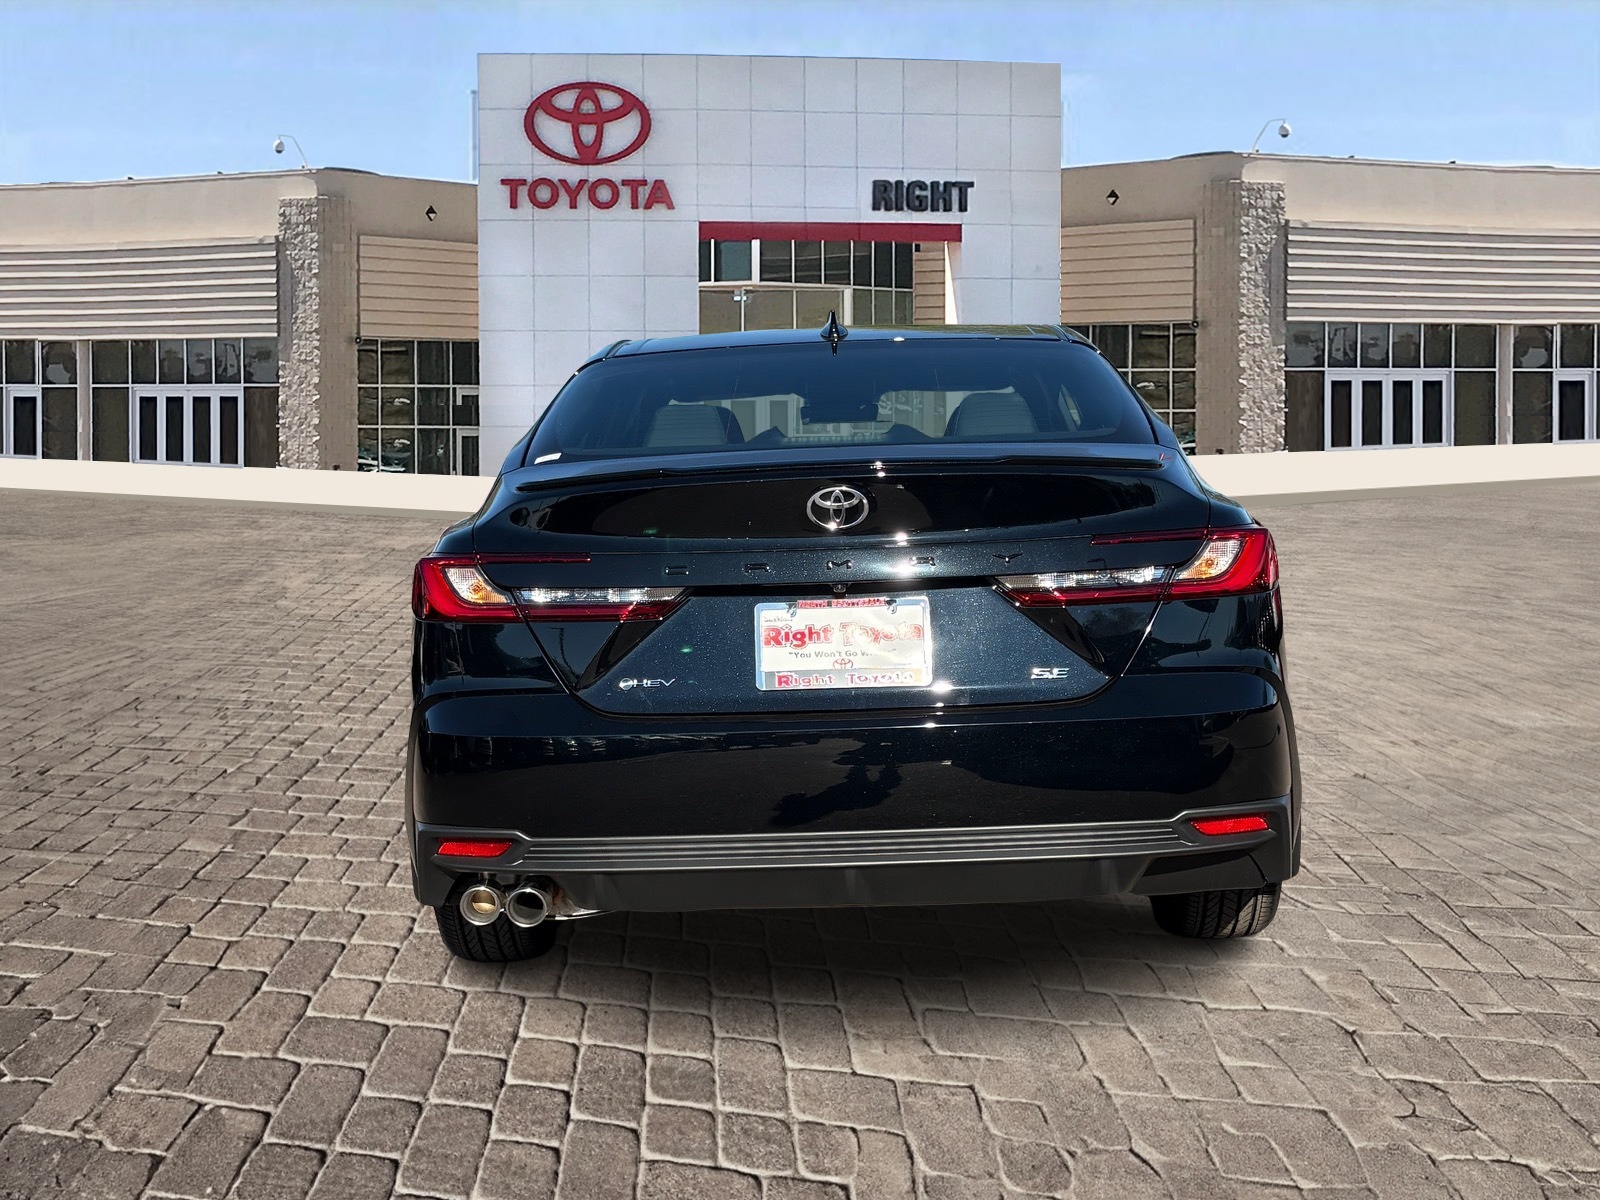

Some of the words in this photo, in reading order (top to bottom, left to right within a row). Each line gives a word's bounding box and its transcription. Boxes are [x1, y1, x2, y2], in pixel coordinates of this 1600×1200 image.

[500, 178, 675, 209] TOYOTA
[871, 179, 975, 213] RIGHT
[763, 624, 834, 649] Right
[814, 650, 842, 658] Won't
[775, 673, 834, 688] Right
[1030, 667, 1070, 679] SE
[633, 678, 676, 688] HEV
